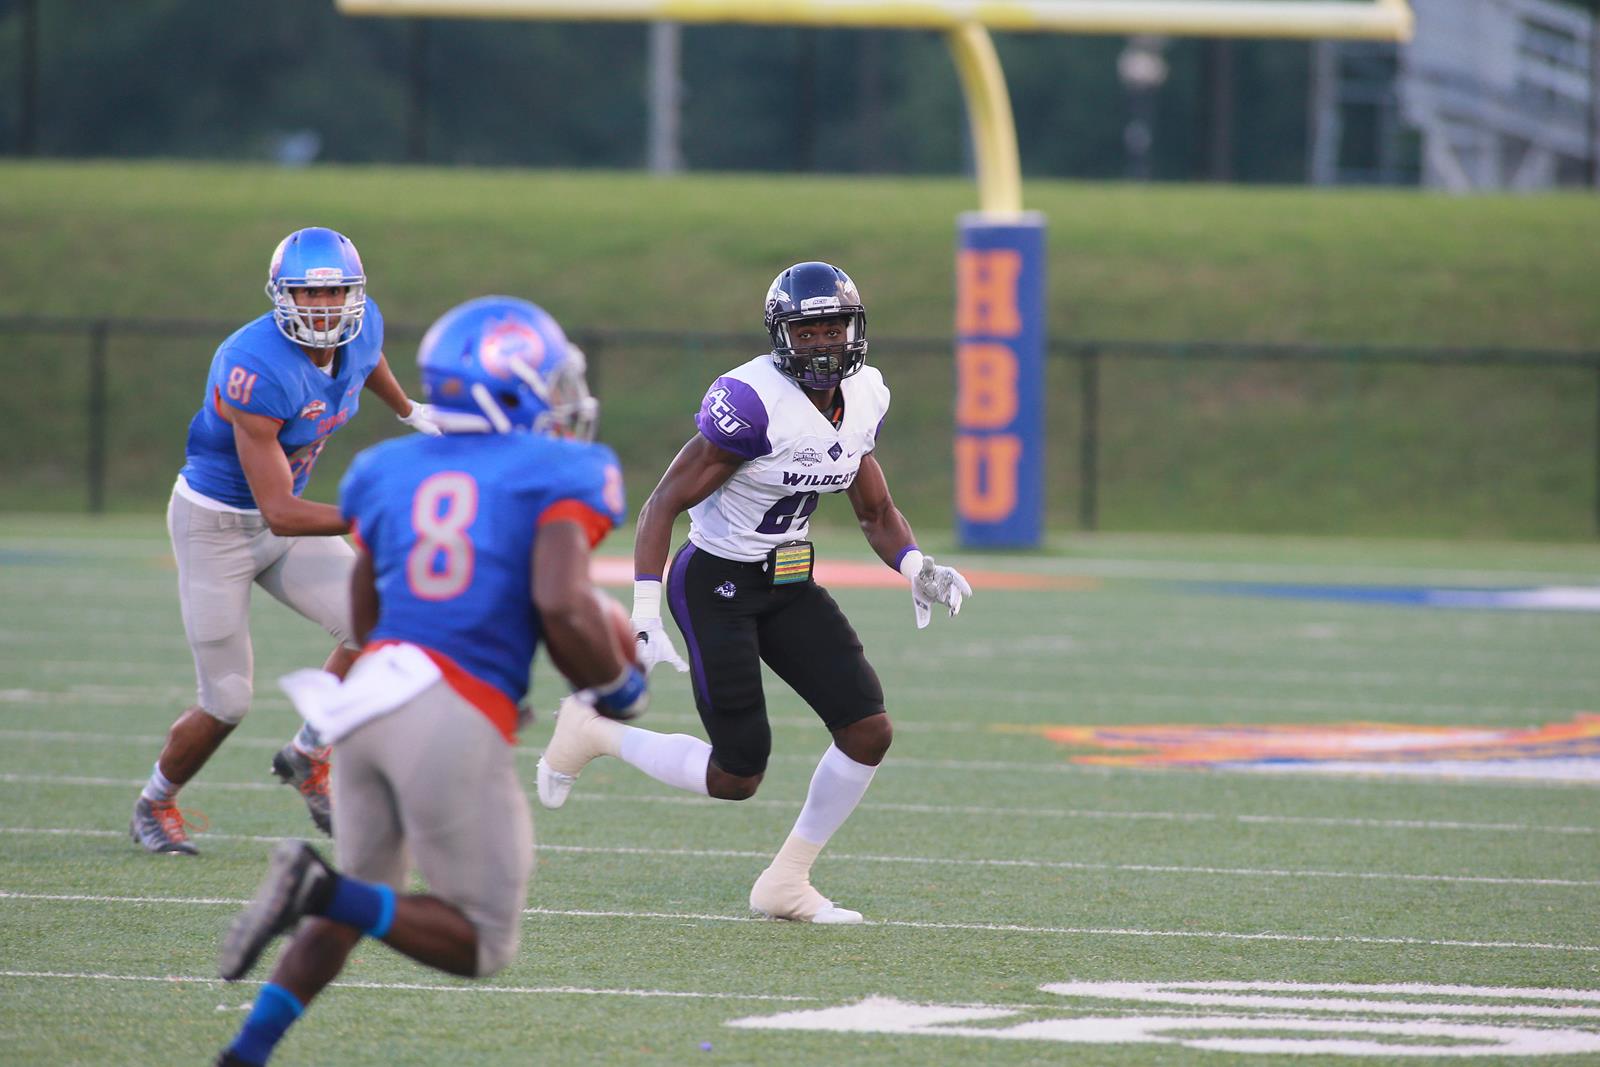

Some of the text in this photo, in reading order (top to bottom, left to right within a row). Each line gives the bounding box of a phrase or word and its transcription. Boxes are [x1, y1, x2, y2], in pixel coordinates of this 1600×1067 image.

[227, 365, 258, 404] 81
[954, 248, 1023, 523] HBU
[708, 386, 747, 436] ACU
[783, 471, 857, 486] WILDCAT
[405, 470, 478, 601] 8
